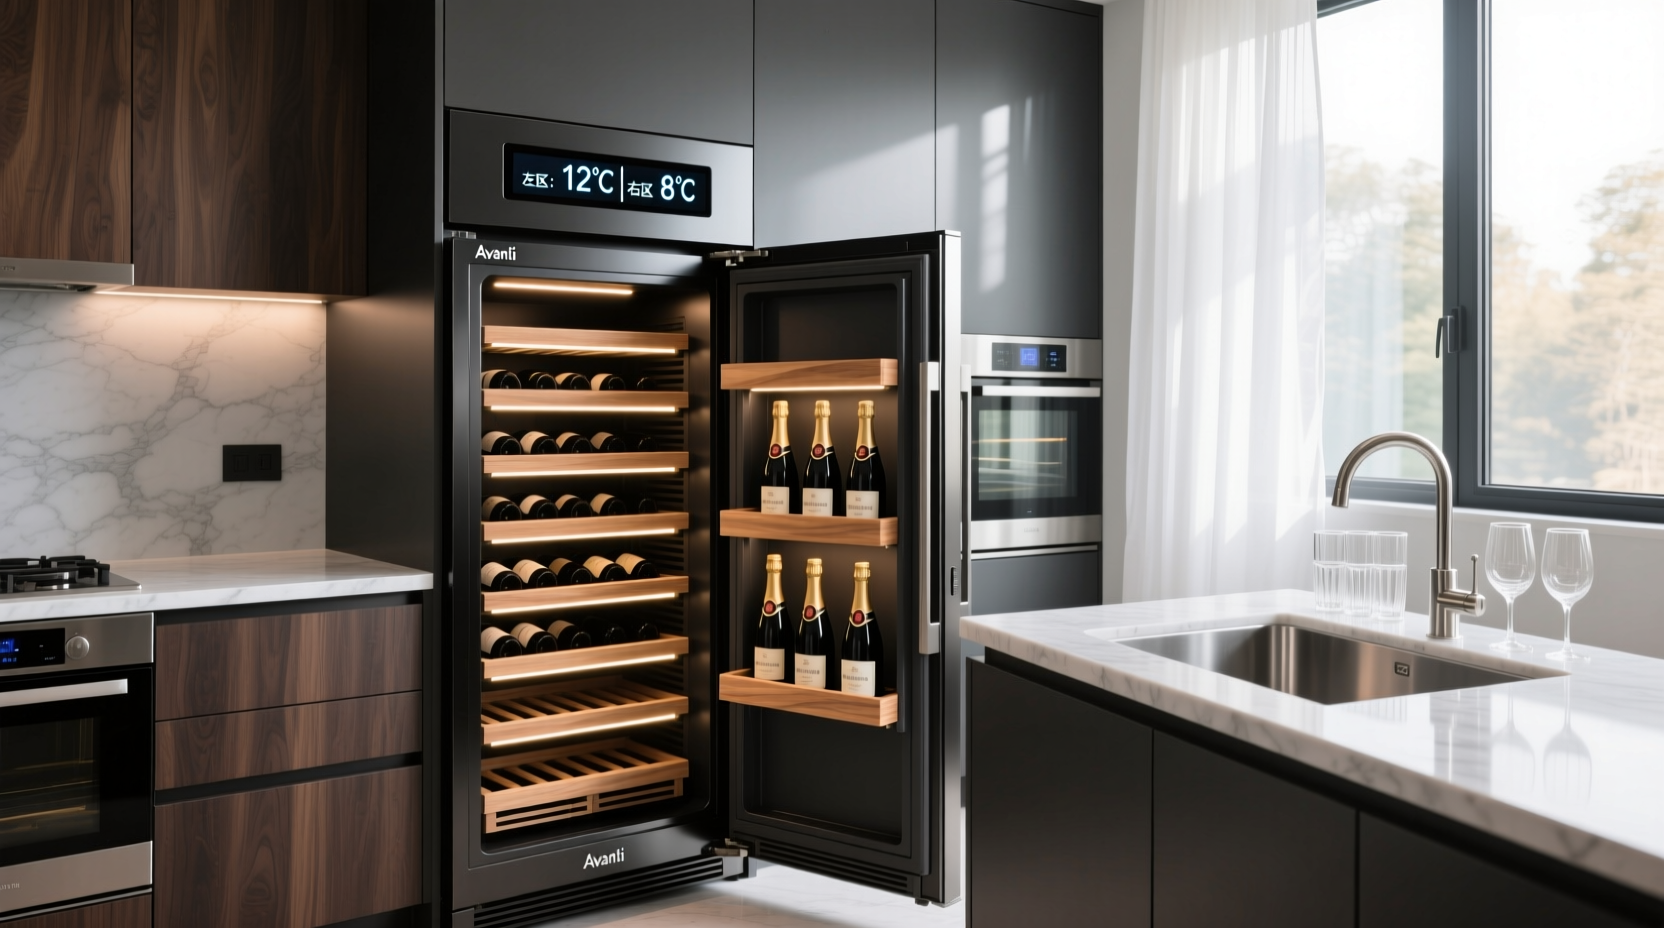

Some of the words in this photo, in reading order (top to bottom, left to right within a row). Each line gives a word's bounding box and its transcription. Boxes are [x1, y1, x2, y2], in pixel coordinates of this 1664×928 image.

[562, 164, 614, 194] 12°C
[627, 180, 653, 198] 右区
[660, 174, 696, 202] 8°C
[474, 244, 516, 261] Avanti
[582, 846, 625, 870] Avanti
